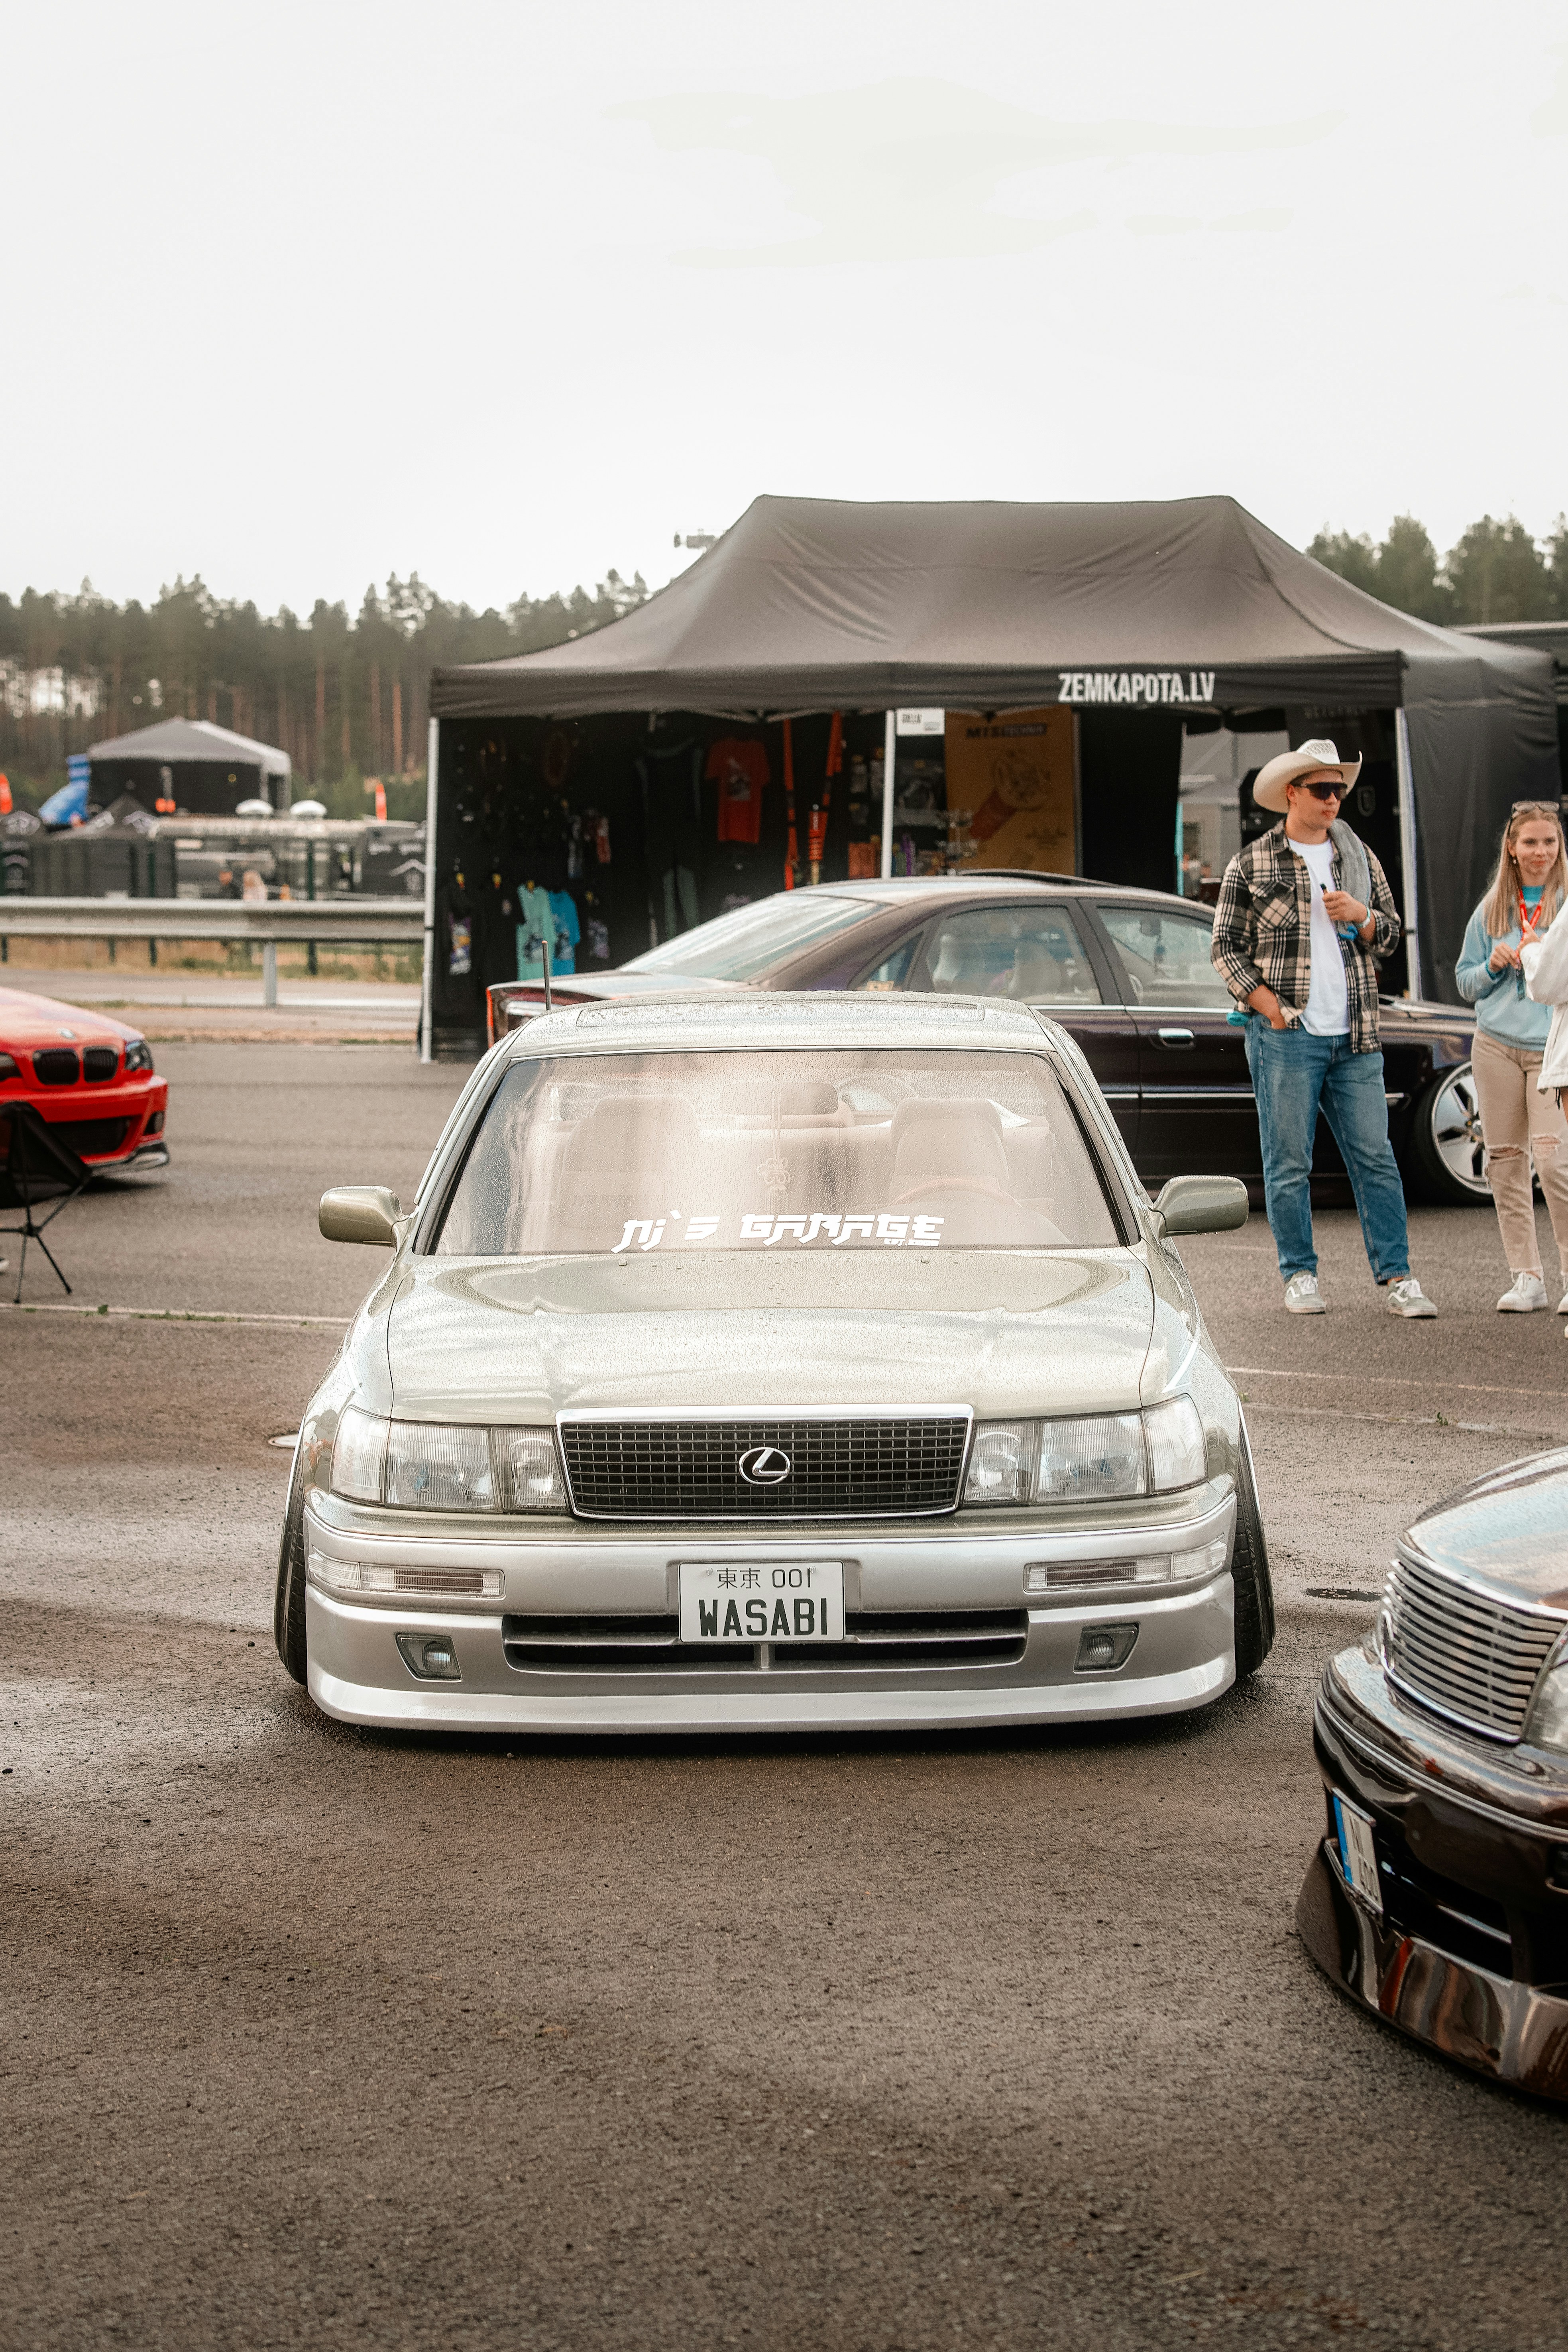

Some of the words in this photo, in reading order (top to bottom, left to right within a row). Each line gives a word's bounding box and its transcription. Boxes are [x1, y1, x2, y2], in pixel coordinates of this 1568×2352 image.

[1058, 672, 1216, 703] ZEMKAPOTA.LV
[739, 1212, 946, 1246] GARAGE
[884, 1238, 940, 1247] EST.200
[717, 1568, 761, 1589] 東京
[772, 1568, 812, 1588] 001
[699, 1597, 828, 1637] WASABI
